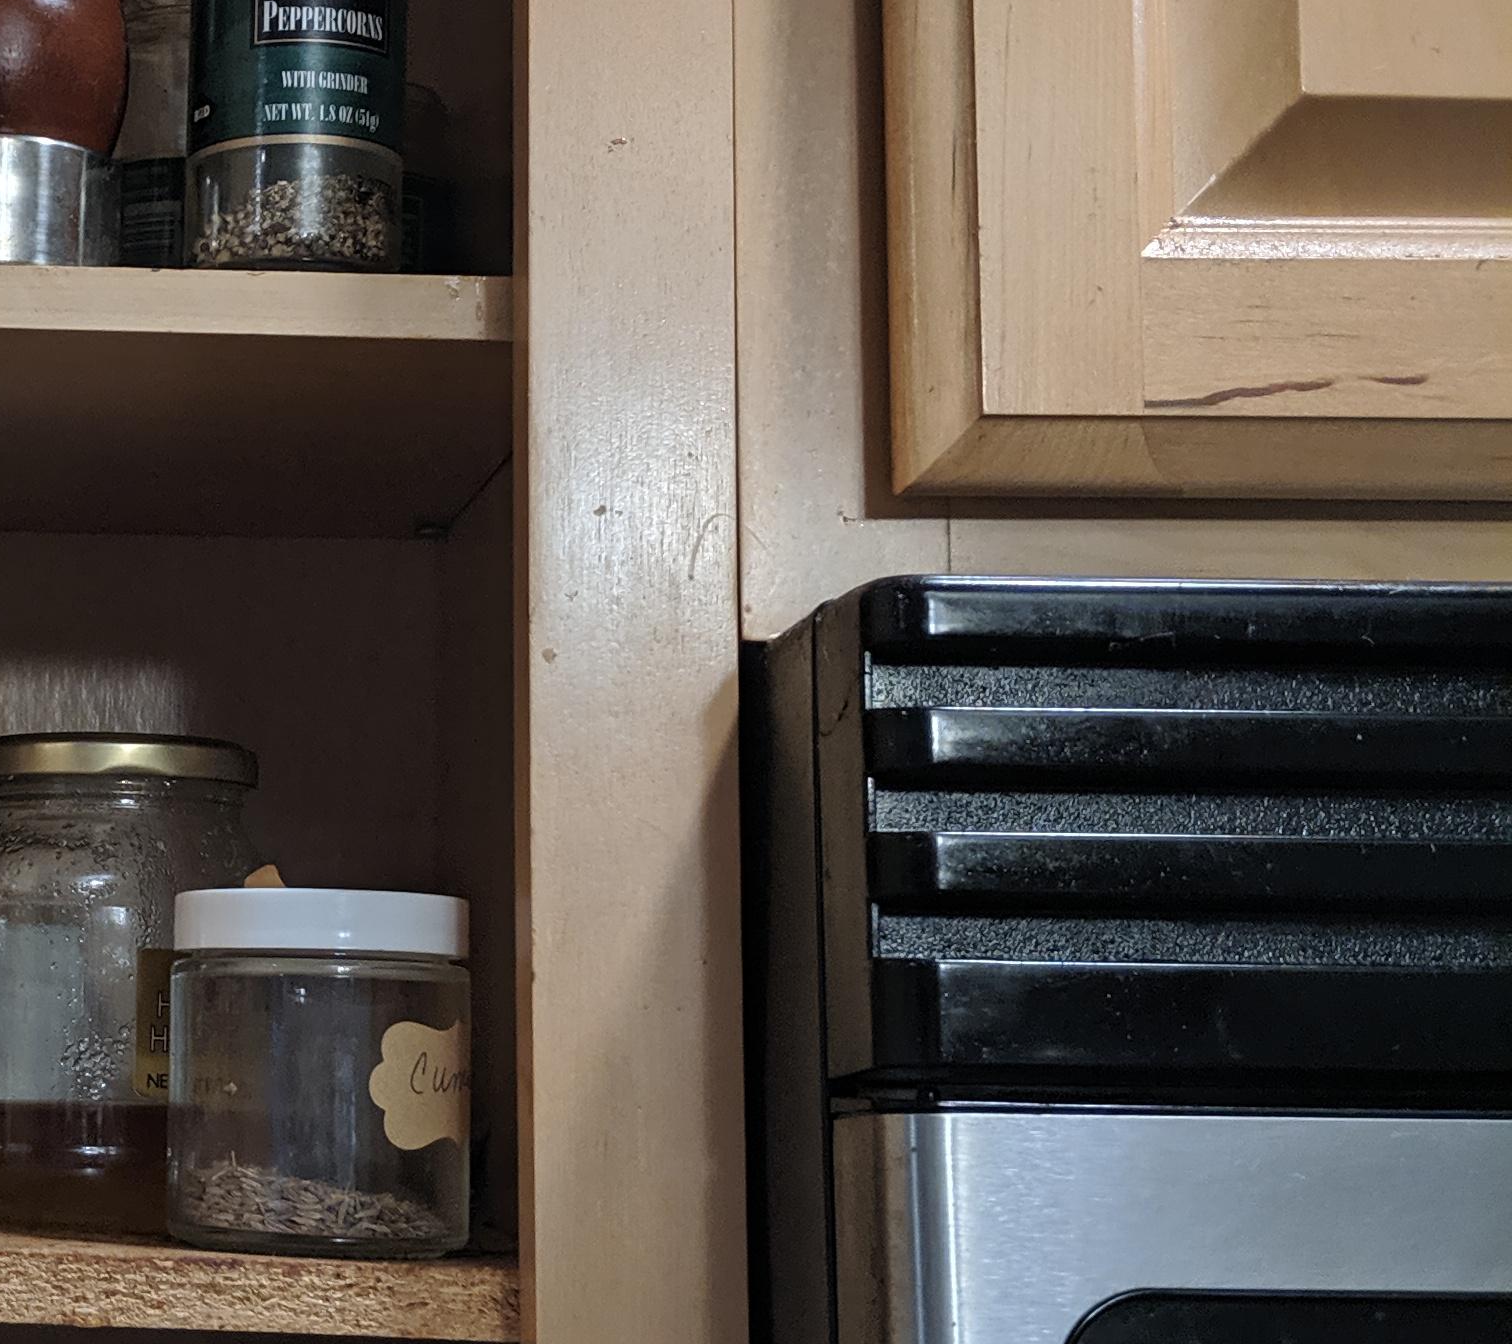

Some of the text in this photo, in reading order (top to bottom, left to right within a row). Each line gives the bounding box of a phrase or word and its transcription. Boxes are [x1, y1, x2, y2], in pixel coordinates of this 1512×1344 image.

[262, 0, 383, 41] PEPPERCORNS
[281, 70, 368, 94] WITH GRINDER
[264, 103, 289, 122] NET
[319, 104, 336, 122] 1.8
[338, 105, 353, 124] OZ
[355, 108, 380, 133] (51g)
